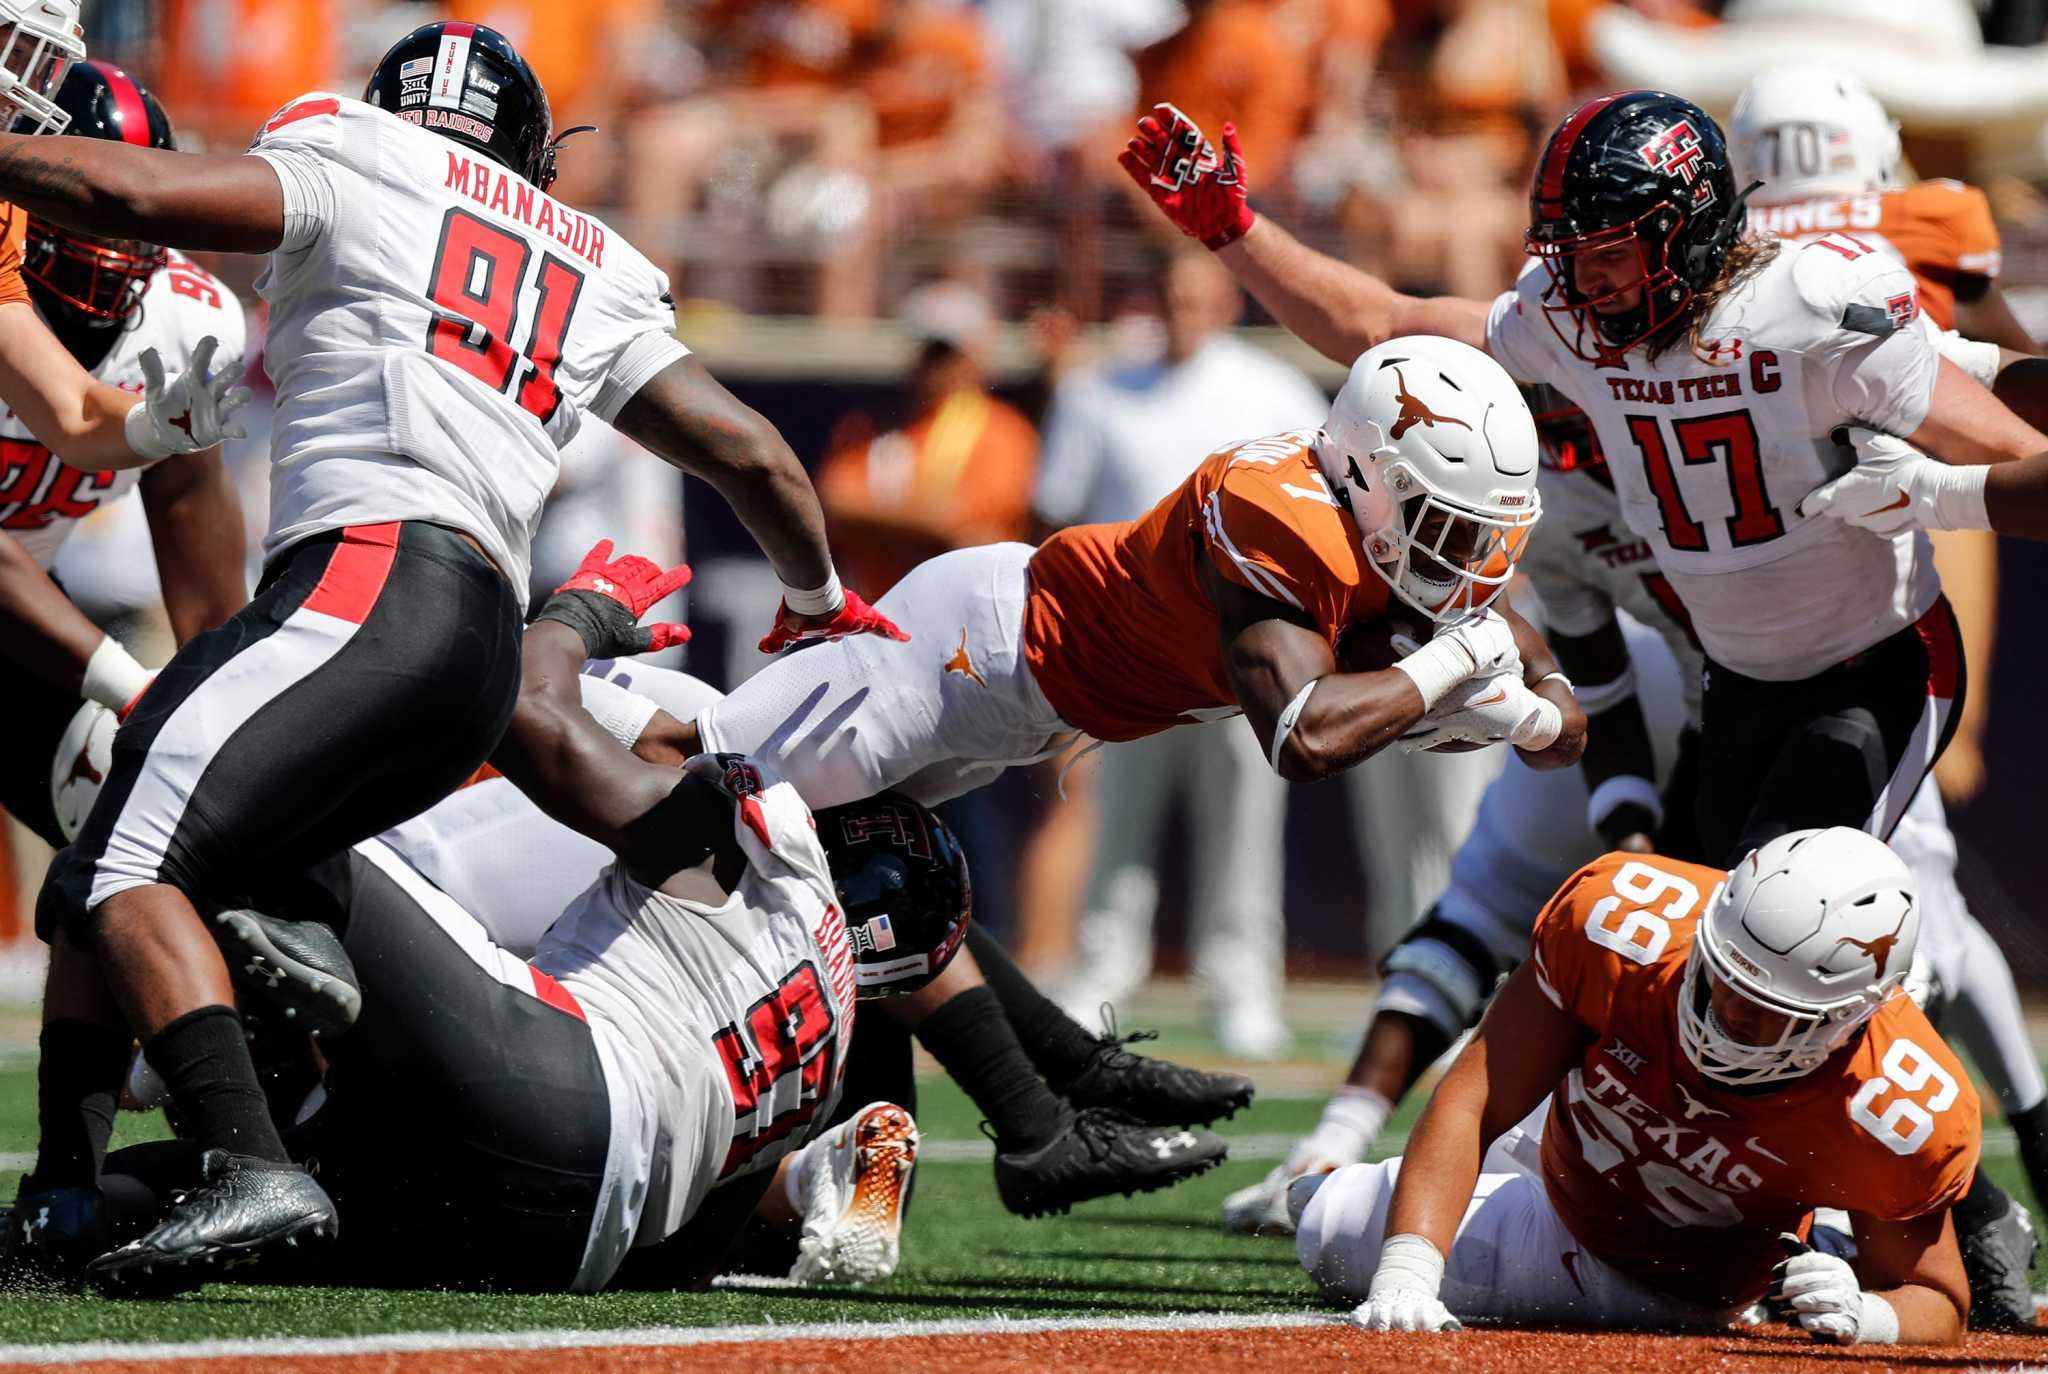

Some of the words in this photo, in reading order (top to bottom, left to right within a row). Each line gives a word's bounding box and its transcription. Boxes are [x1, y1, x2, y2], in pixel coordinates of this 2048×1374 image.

[401, 92, 427, 107] UNITY
[426, 110, 494, 143] RAIDERS
[1756, 121, 1820, 178] 70
[444, 150, 606, 270] MBANASOR
[425, 205, 587, 427] 91
[1606, 377, 1676, 405] TEXAS
[1678, 373, 1742, 402] TECH
[1750, 350, 1782, 394] C
[1499, 494, 1526, 507] HORNS
[1624, 408, 1786, 552] 17
[1585, 861, 1700, 966] 69
[1729, 948, 1761, 977] HORNS
[1849, 1037, 1961, 1156] 69
[1586, 1063, 1764, 1194] TEXAS
